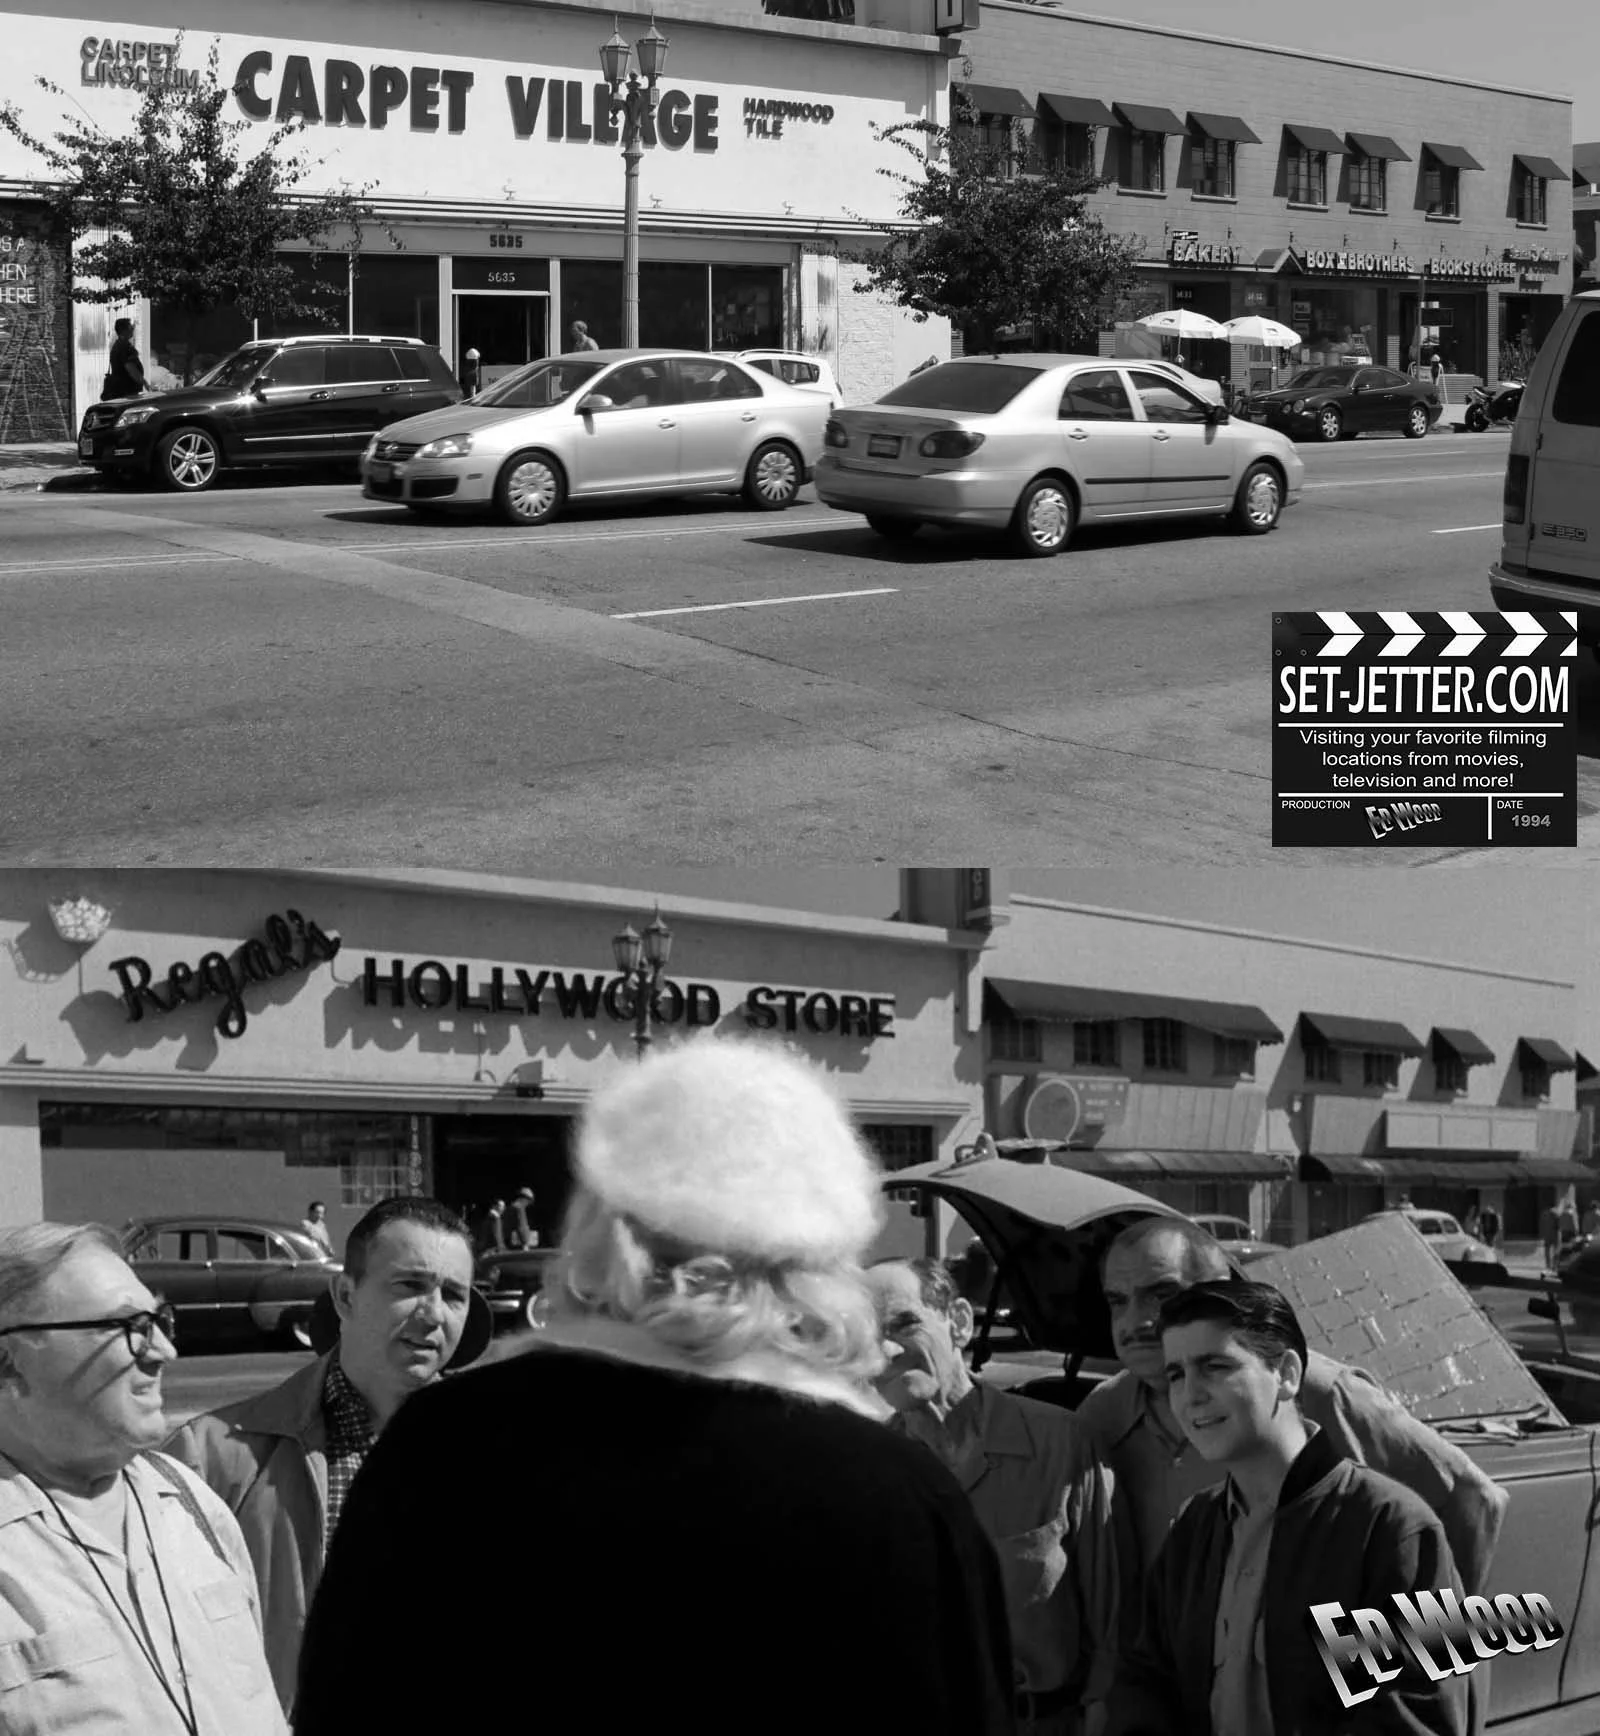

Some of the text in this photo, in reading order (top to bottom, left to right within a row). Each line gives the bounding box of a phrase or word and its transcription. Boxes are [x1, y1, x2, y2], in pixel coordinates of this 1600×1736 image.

[80, 36, 179, 65] CARPET
[234, 51, 719, 154] CARPET VILLAGE
[743, 97, 834, 124] HARDWOOD
[744, 118, 783, 140] TILE
[1172, 240, 1240, 265] BAKERY
[1305, 250, 1415, 273] BOX BROTHERS
[488, 271, 516, 282] 5635
[109, 909, 896, 1039] Regal's HOLLYWOOD STORE
